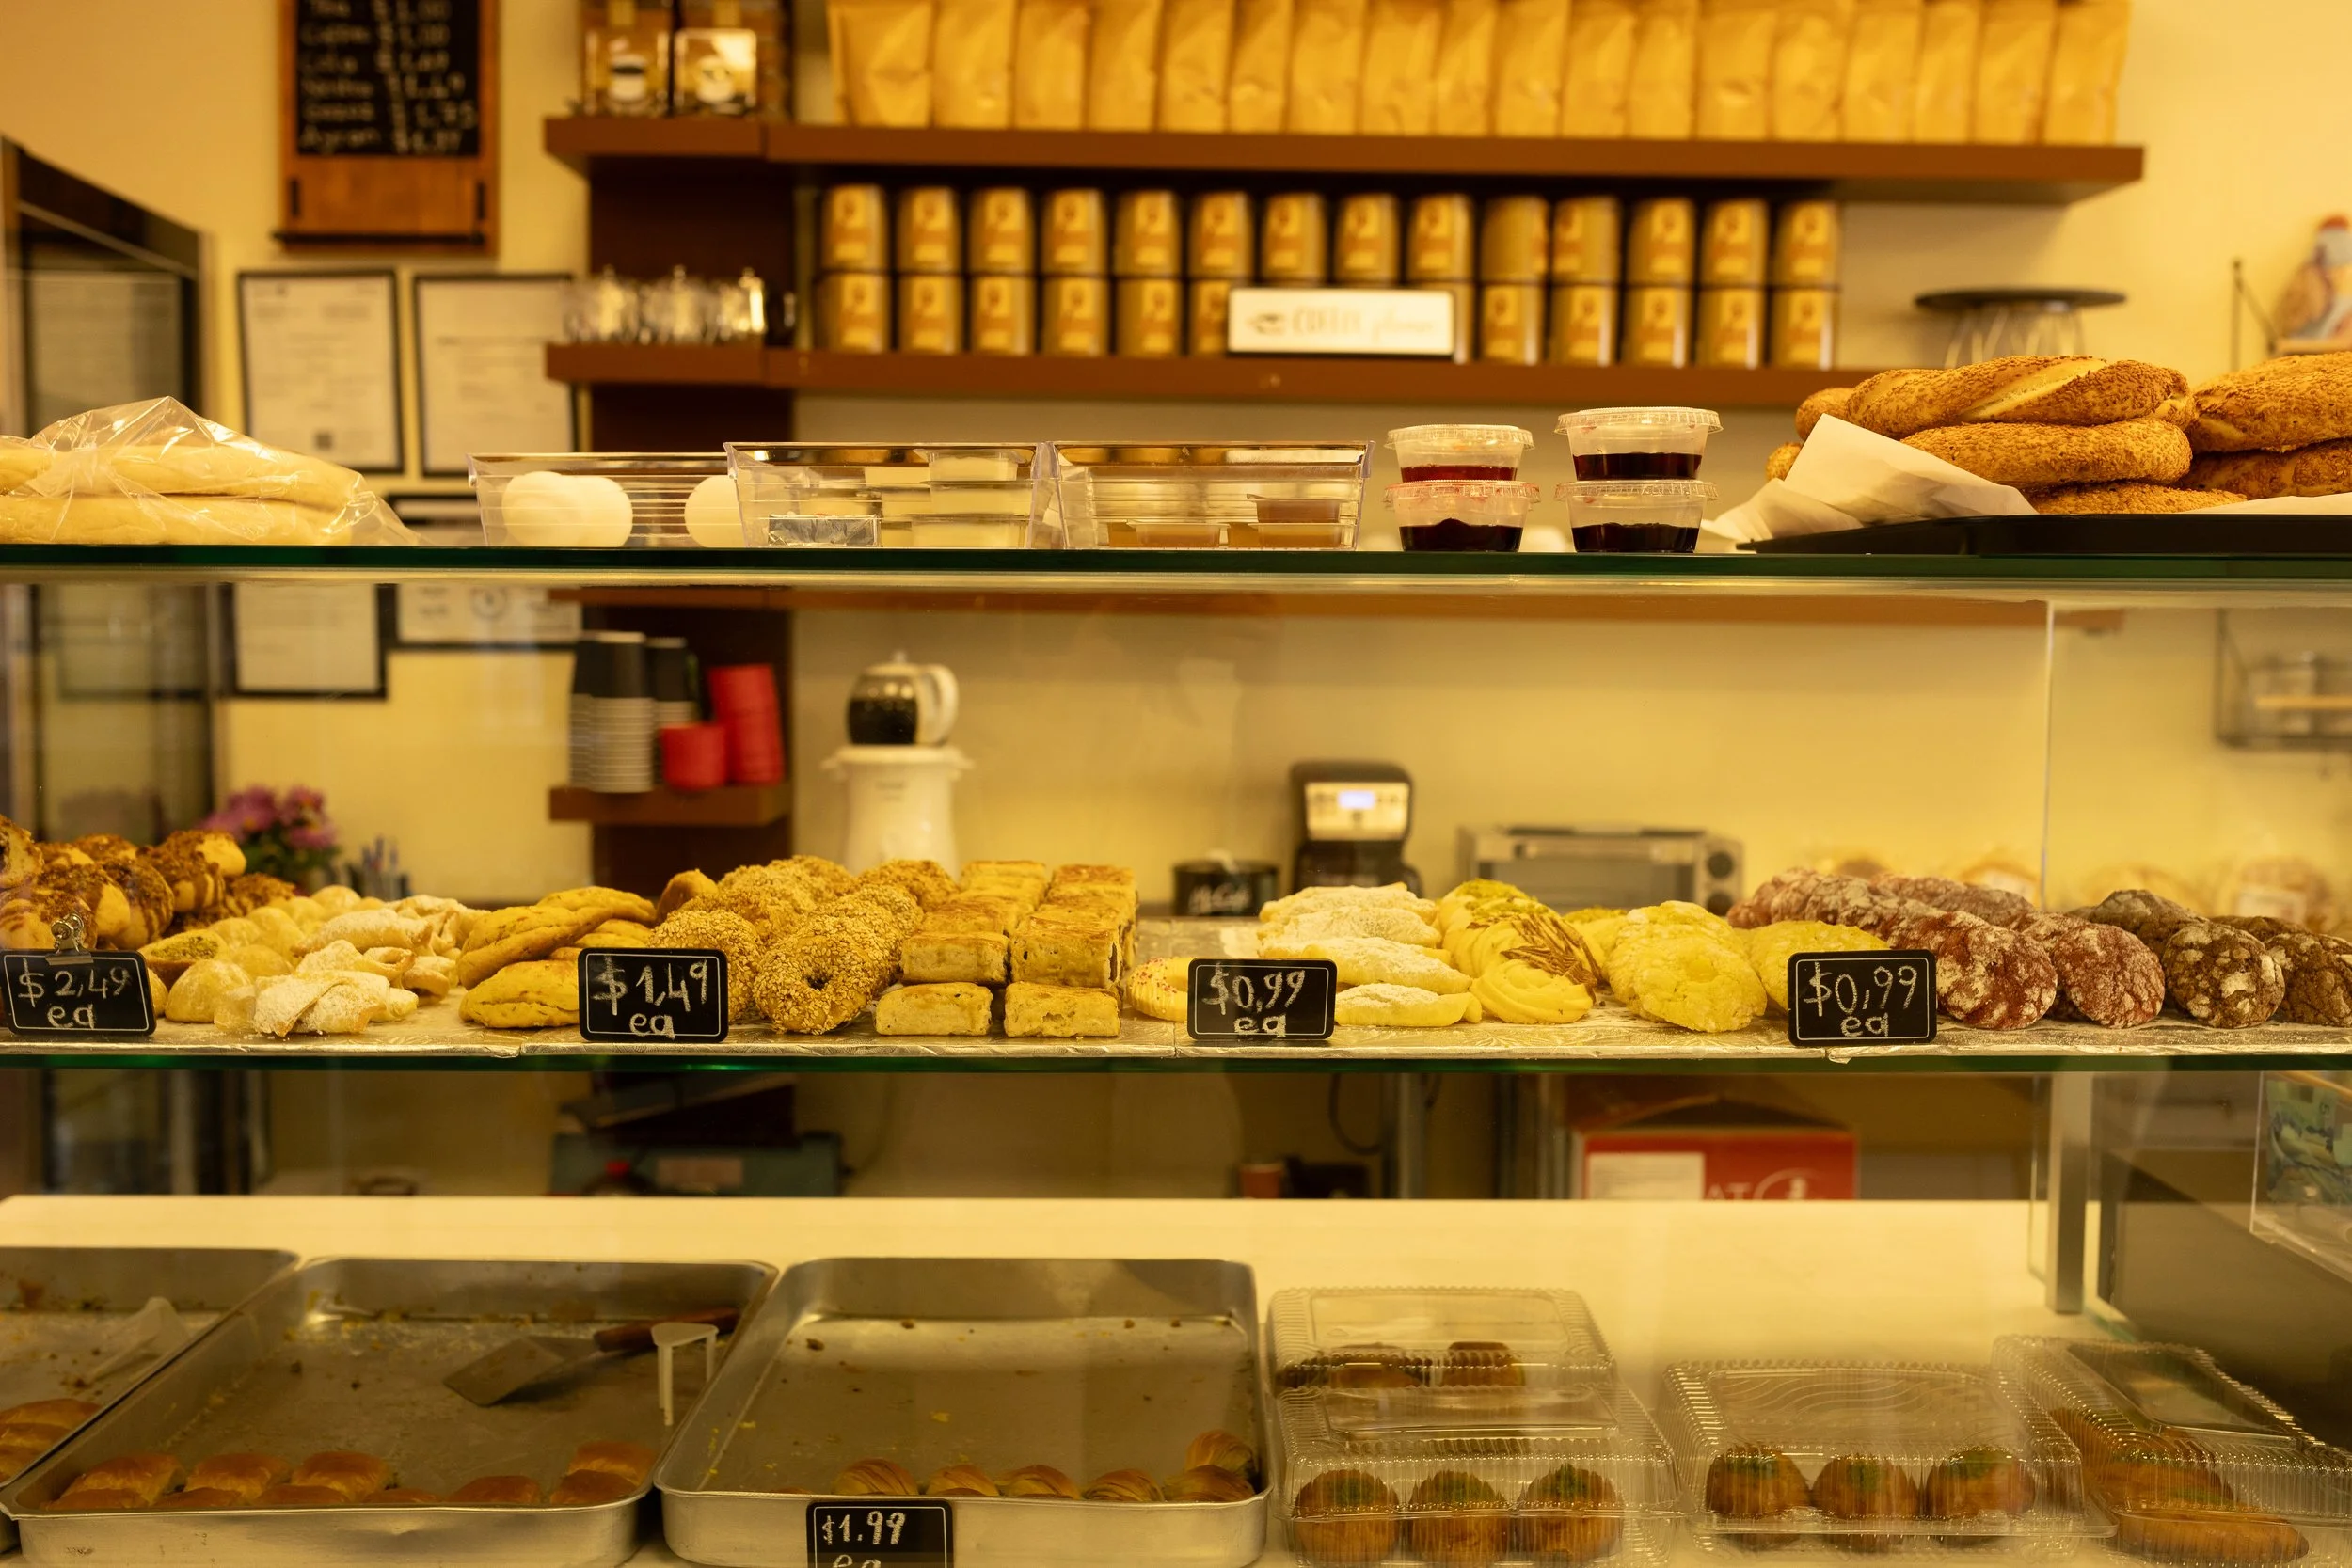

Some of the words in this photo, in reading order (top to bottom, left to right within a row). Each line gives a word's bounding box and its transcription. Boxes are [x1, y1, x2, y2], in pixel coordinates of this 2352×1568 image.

[47, 1003, 95, 1029] ea
[629, 1013, 675, 1039] ea
[1233, 1014, 1287, 1037] ea
[1840, 1012, 1889, 1037] ea
[821, 1510, 906, 1545] $1.99
